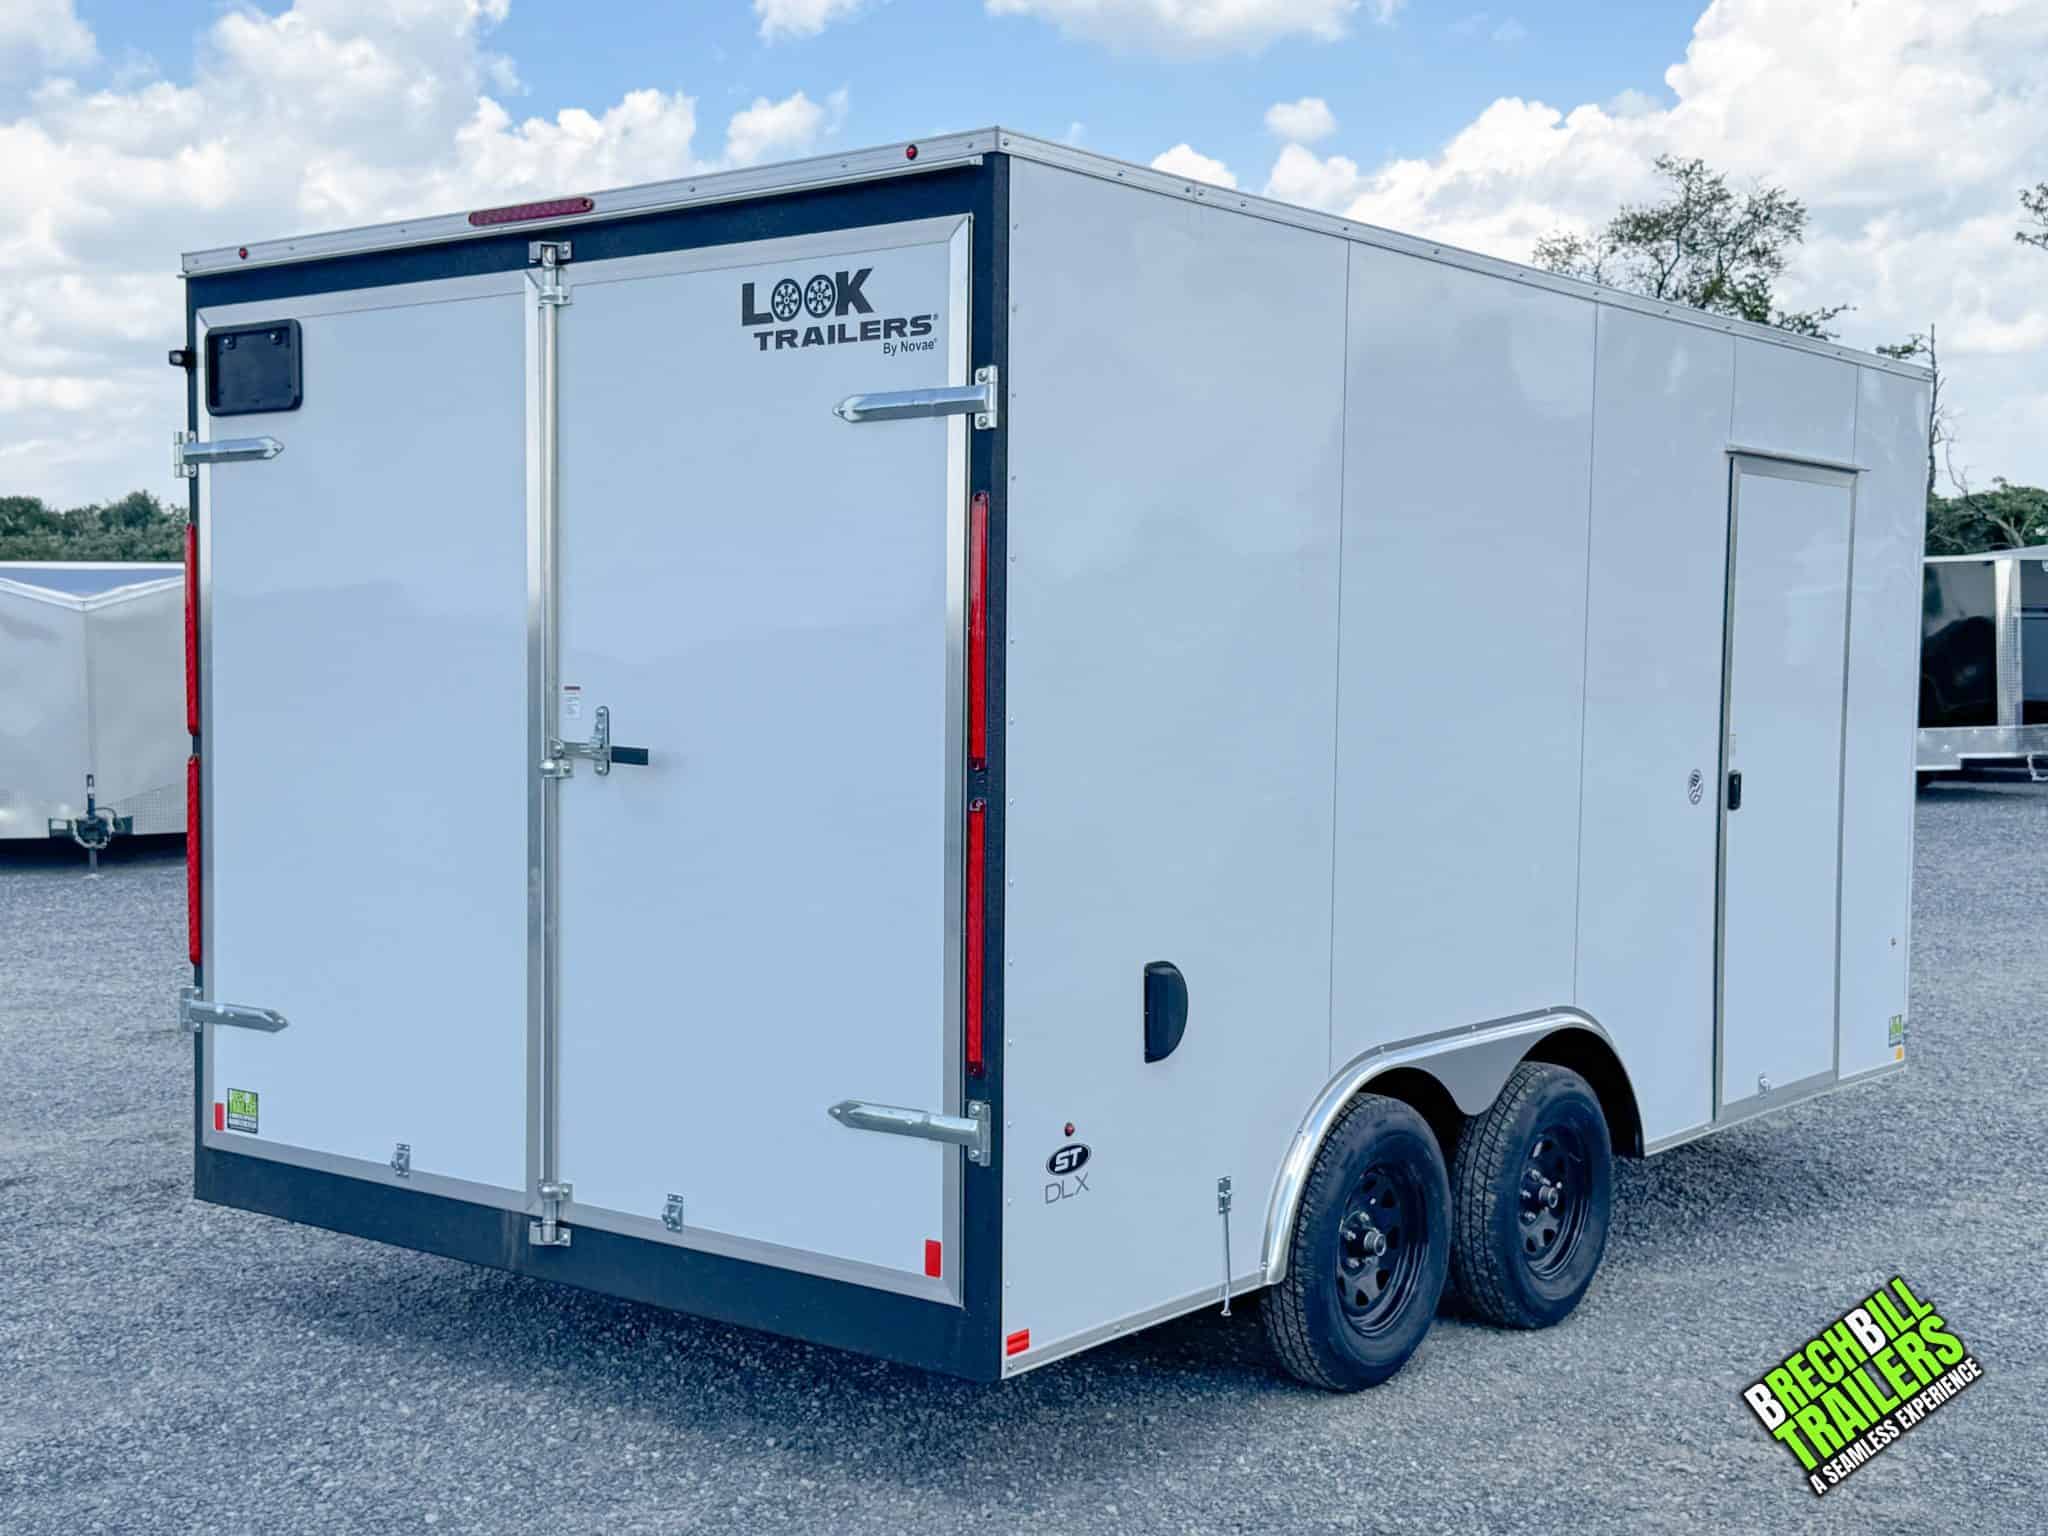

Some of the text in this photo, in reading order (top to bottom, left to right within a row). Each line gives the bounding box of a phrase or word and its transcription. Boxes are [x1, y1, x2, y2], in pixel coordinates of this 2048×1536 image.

[741, 267, 874, 326] LOOK
[883, 342, 897, 356] By
[1044, 1171, 1090, 1204] DLX
